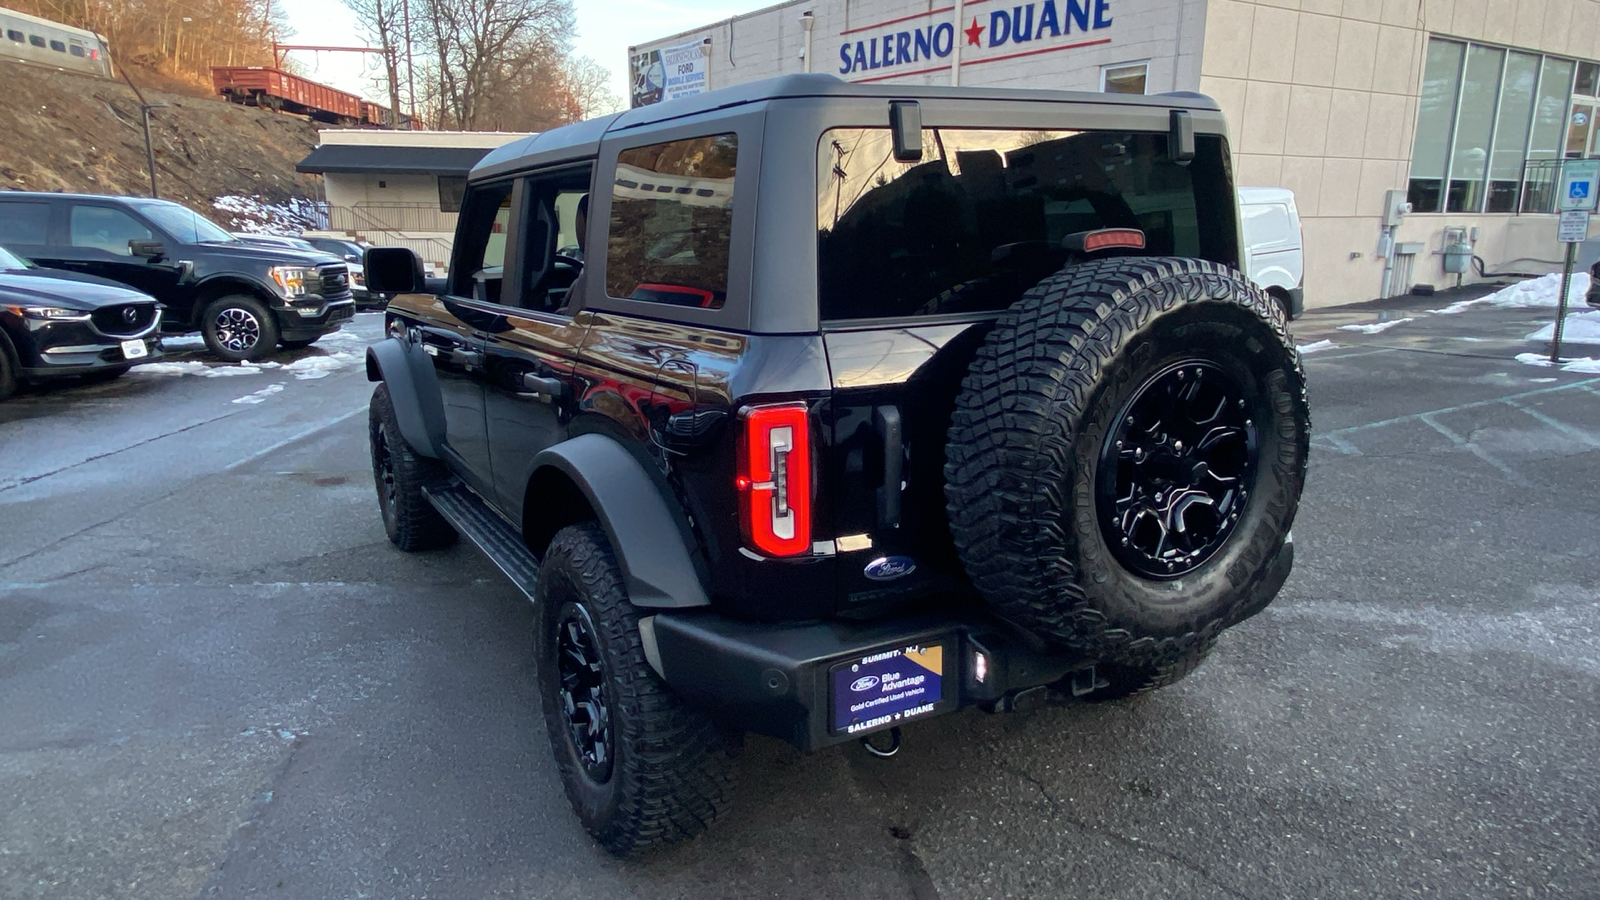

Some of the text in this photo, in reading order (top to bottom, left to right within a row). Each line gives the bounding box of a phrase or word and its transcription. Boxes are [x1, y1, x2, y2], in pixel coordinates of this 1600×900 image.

[839, 0, 1114, 75] SALERNO DUANE
[678, 63, 693, 75] FORD
[1226, 368, 1297, 590] GOODYEAR
[861, 645, 919, 665] SUMMIT, NJ
[881, 672, 900, 683] Blue
[881, 674, 925, 692] Advantage
[850, 687, 925, 712] Gold Certified Used Vehicle
[847, 703, 934, 733] SALERNO DUANE
